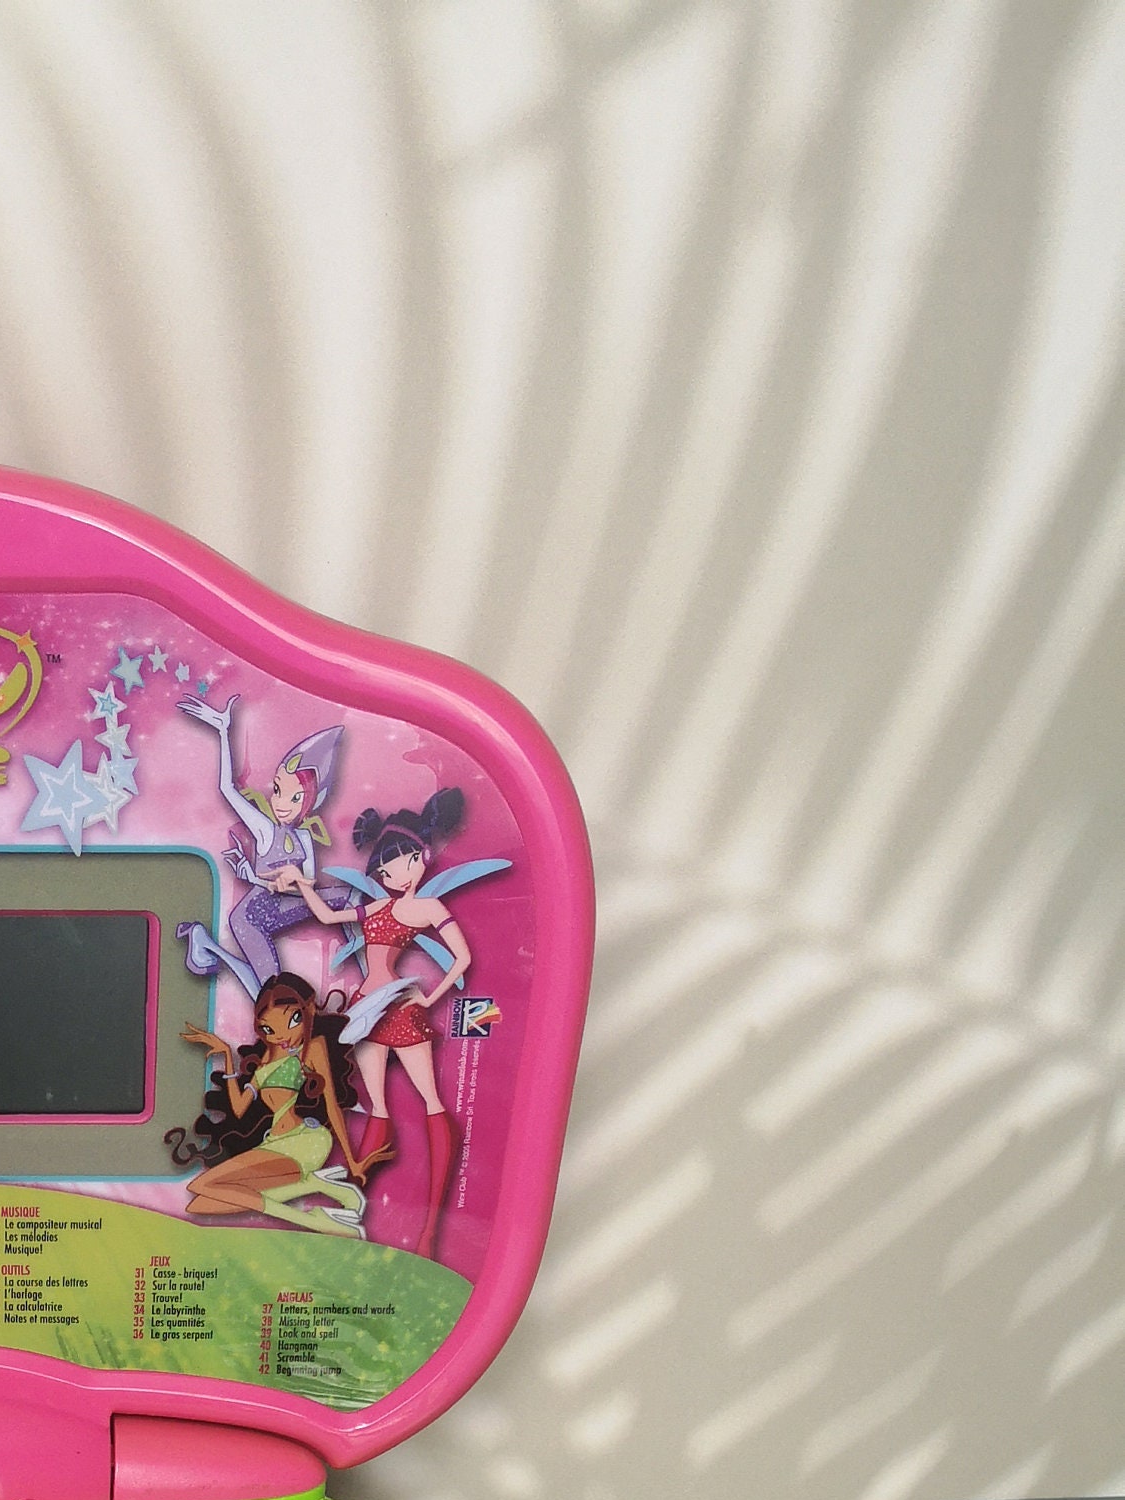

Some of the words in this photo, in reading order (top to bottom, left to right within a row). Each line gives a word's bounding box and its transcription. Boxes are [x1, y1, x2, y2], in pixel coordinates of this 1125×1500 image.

[451, 998, 461, 1037] RAINBOW
[1, 1207, 40, 1217] MUSIQUE
[5, 1219, 14, 1229] Le
[17, 1219, 67, 1233] compositeur
[70, 1218, 102, 1229] musical
[5, 1231, 18, 1241] Les
[21, 1231, 58, 1241] mélodies
[4, 1244, 42, 1256] Musique!
[149, 1256, 170, 1267] JEUX
[1, 1265, 30, 1275] OUTILS
[153, 1268, 176, 1278] Casse
[183, 1267, 218, 1280] briques!
[5, 1277, 14, 1287] La
[46, 1276, 60, 1287] des
[63, 1276, 88, 1287] lettres
[153, 1280, 166, 1290] Sur
[169, 1280, 176, 1290] la
[180, 1281, 204, 1290] route!
[152, 1293, 182, 1303] Trouve!
[277, 1292, 313, 1302] ANGLAIS
[4, 1301, 13, 1311] La
[17, 1301, 62, 1311] calculatrice
[152, 1305, 161, 1315] Le
[280, 1305, 310, 1315] Letters,
[313, 1304, 349, 1315] numbers
[352, 1304, 368, 1314] and
[371, 1304, 395, 1315] words
[4, 1313, 27, 1323] Notes
[30, 1314, 37, 1323] et
[40, 1316, 79, 1325] messages
[151, 1317, 164, 1327] Les
[167, 1318, 204, 1329] quantités
[279, 1317, 310, 1328] Missing
[151, 1329, 160, 1339] Le
[162, 1332, 180, 1341] gros
[183, 1330, 213, 1341] serpent
[278, 1341, 318, 1352] Hangman
[277, 1353, 315, 1362] Scramble
